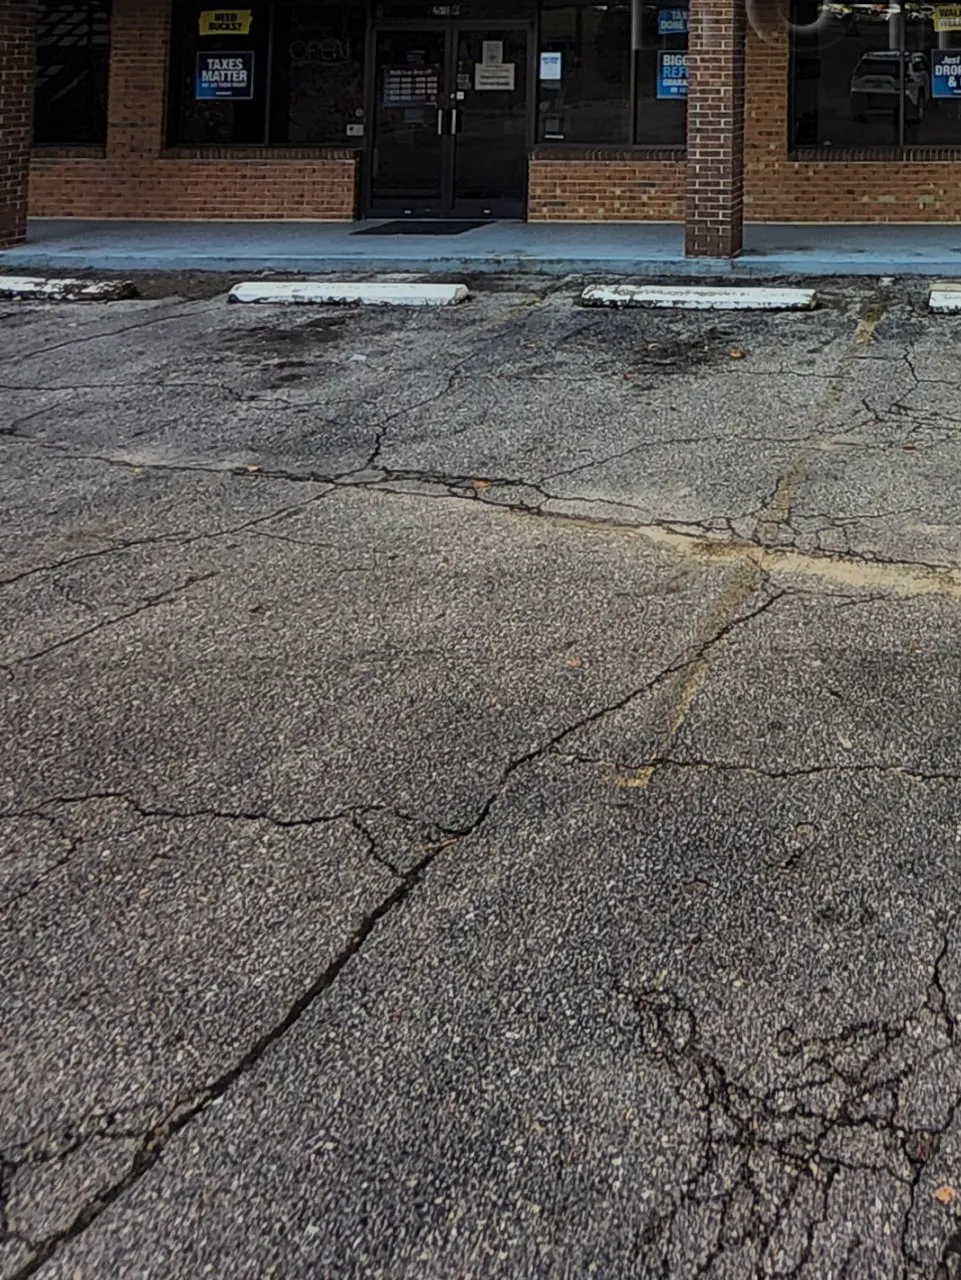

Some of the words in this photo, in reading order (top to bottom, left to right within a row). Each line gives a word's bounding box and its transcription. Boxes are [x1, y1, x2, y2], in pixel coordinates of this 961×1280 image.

[660, 20, 684, 30] DONE
[206, 58, 244, 70] TAXES
[941, 55, 961, 65] Just
[201, 70, 248, 82] MATTER
[947, 77, 957, 88] &
